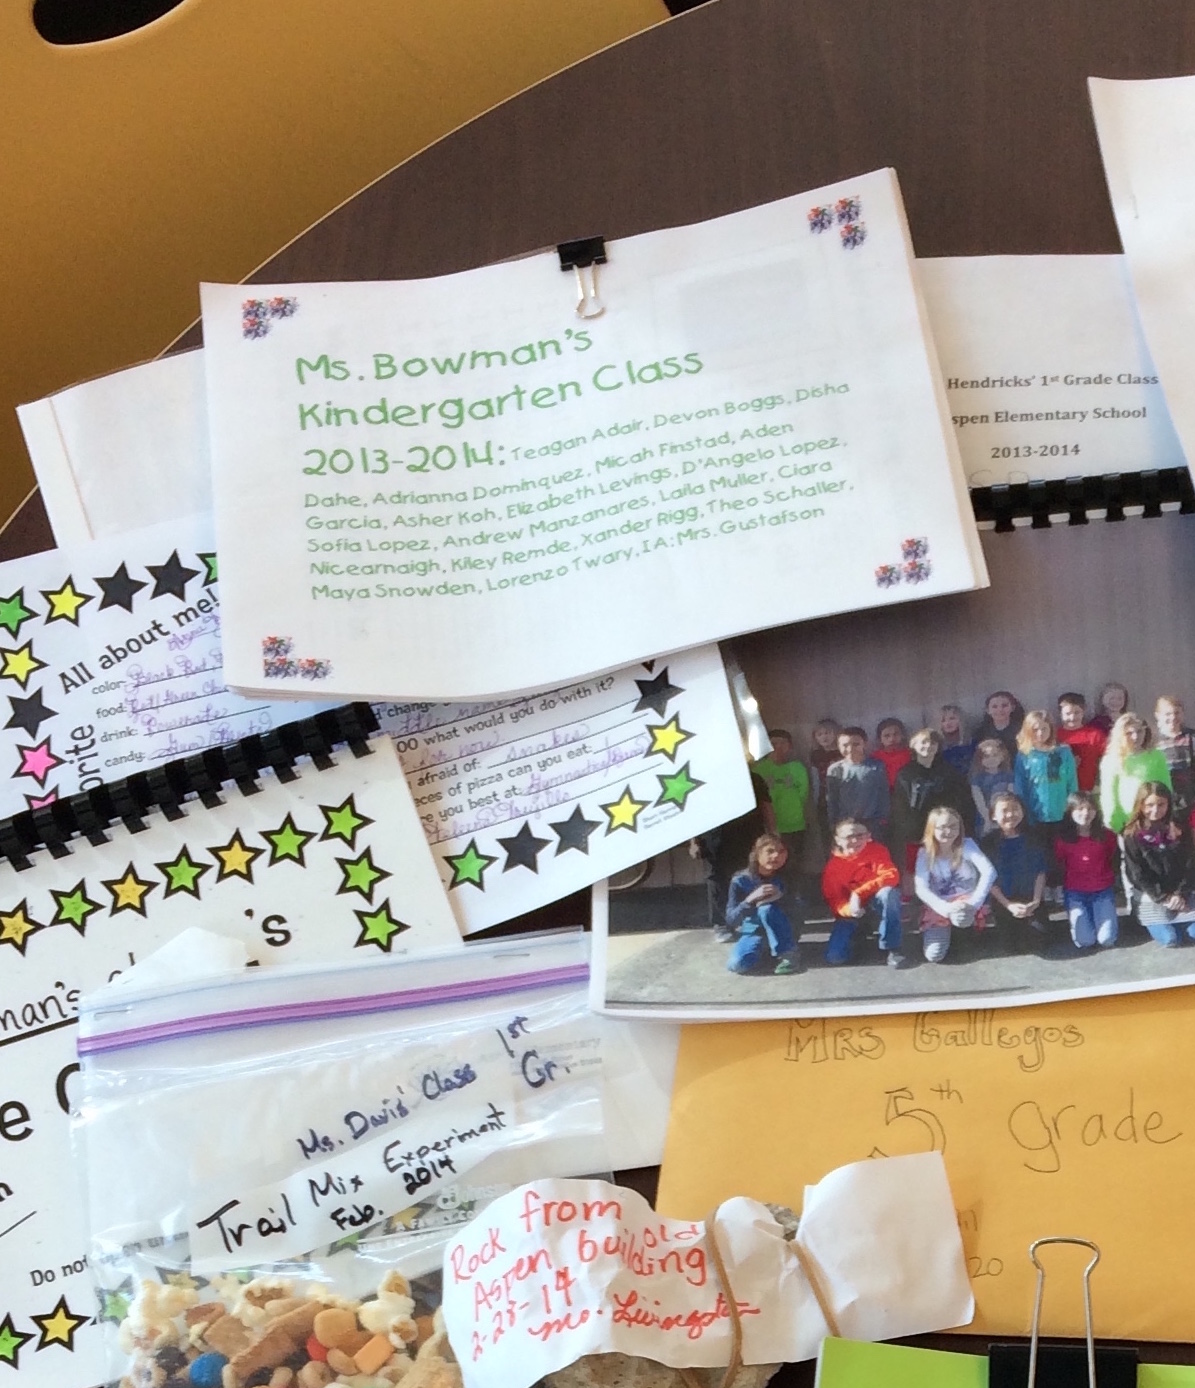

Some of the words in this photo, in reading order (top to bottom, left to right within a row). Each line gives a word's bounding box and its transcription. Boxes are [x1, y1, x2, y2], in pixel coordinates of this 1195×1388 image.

[295, 354, 365, 385] Ms.
[371, 328, 594, 381] Bowman's
[298, 379, 583, 431] Kindergarten
[591, 351, 704, 392] Class
[1063, 373, 1113, 386] Grade
[1116, 372, 1160, 386] Class
[510, 434, 587, 463] Teagan
[592, 418, 650, 441] Adair,
[653, 407, 720, 429] Devon
[723, 393, 792, 414] Boggs,
[795, 382, 851, 403] Disha
[951, 413, 990, 428] spen
[994, 407, 1089, 424] Elementary
[1092, 406, 1148, 420] School
[990, 443, 1082, 460] 2013-2014
[302, 440, 506, 476] 2013-2014:
[304, 491, 367, 509] Dahe,
[372, 487, 468, 507] Adrianna
[595, 446, 655, 474] Micah
[740, 422, 794, 441] Aden
[58, 662, 95, 694] All
[99, 620, 171, 671] about
[171, 587, 219, 628] me!
[196, 1193, 297, 1254] Trail
[308, 1171, 364, 1207] Mix
[383, 1102, 507, 1173] Experiment
[329, 1203, 385, 1231] Feb.
[402, 1153, 458, 1195] 2014
[451, 1227, 507, 1283] Rock
[520, 1190, 622, 1233] from
[577, 1230, 706, 1286] building
